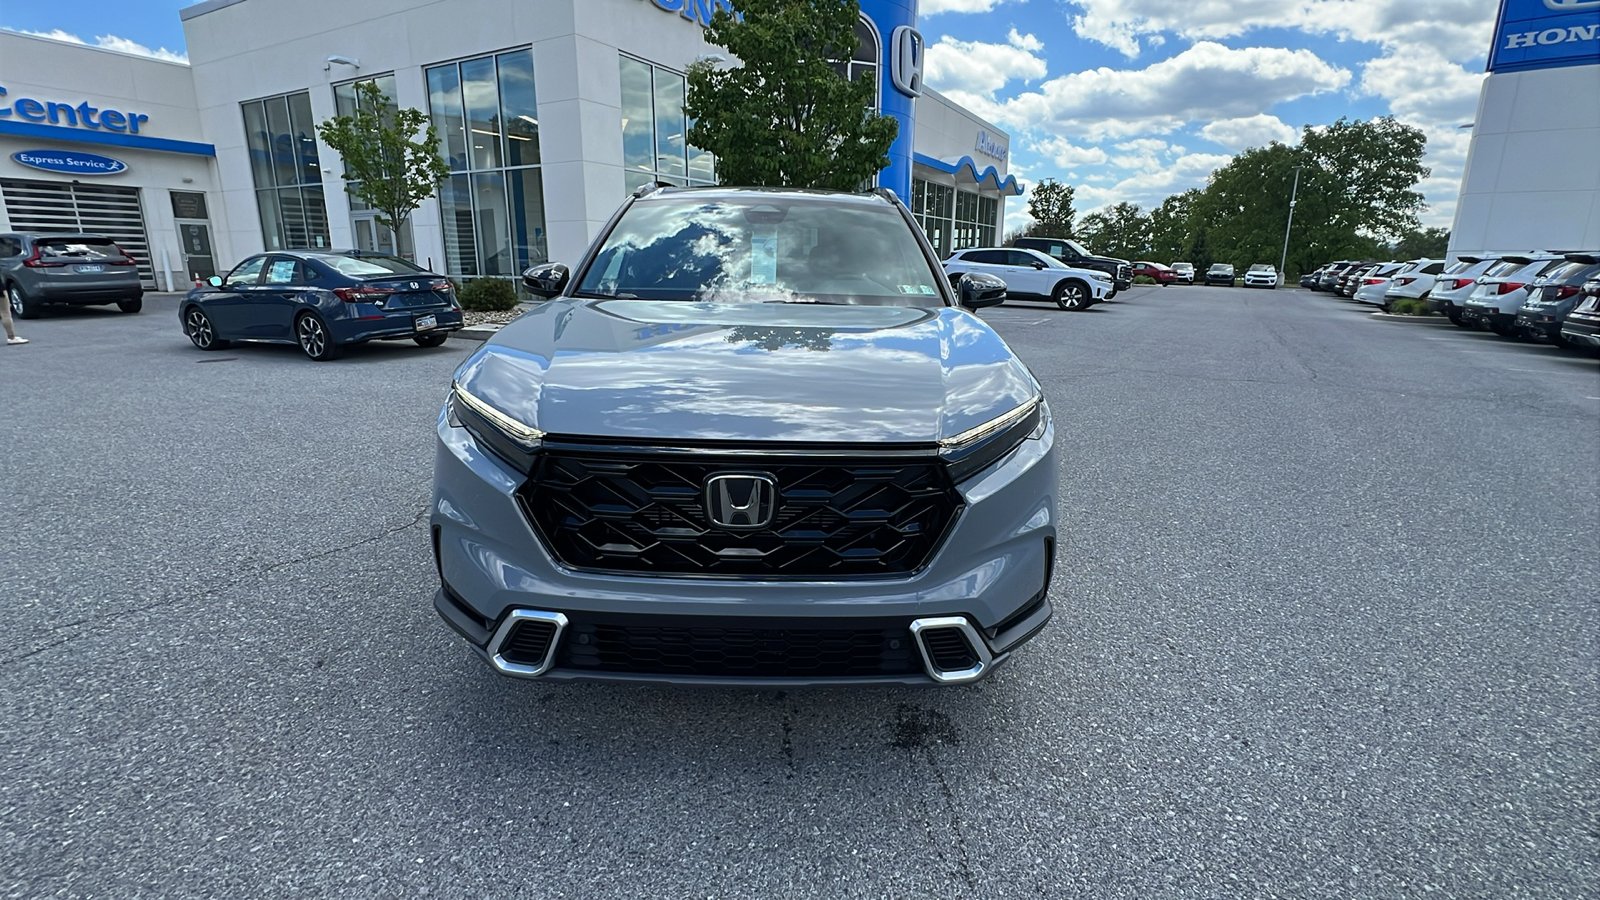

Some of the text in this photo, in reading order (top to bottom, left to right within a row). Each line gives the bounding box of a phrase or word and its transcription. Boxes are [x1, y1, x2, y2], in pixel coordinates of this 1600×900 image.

[1504, 24, 1600, 49] HON
[20, 153, 106, 169] Express Service
